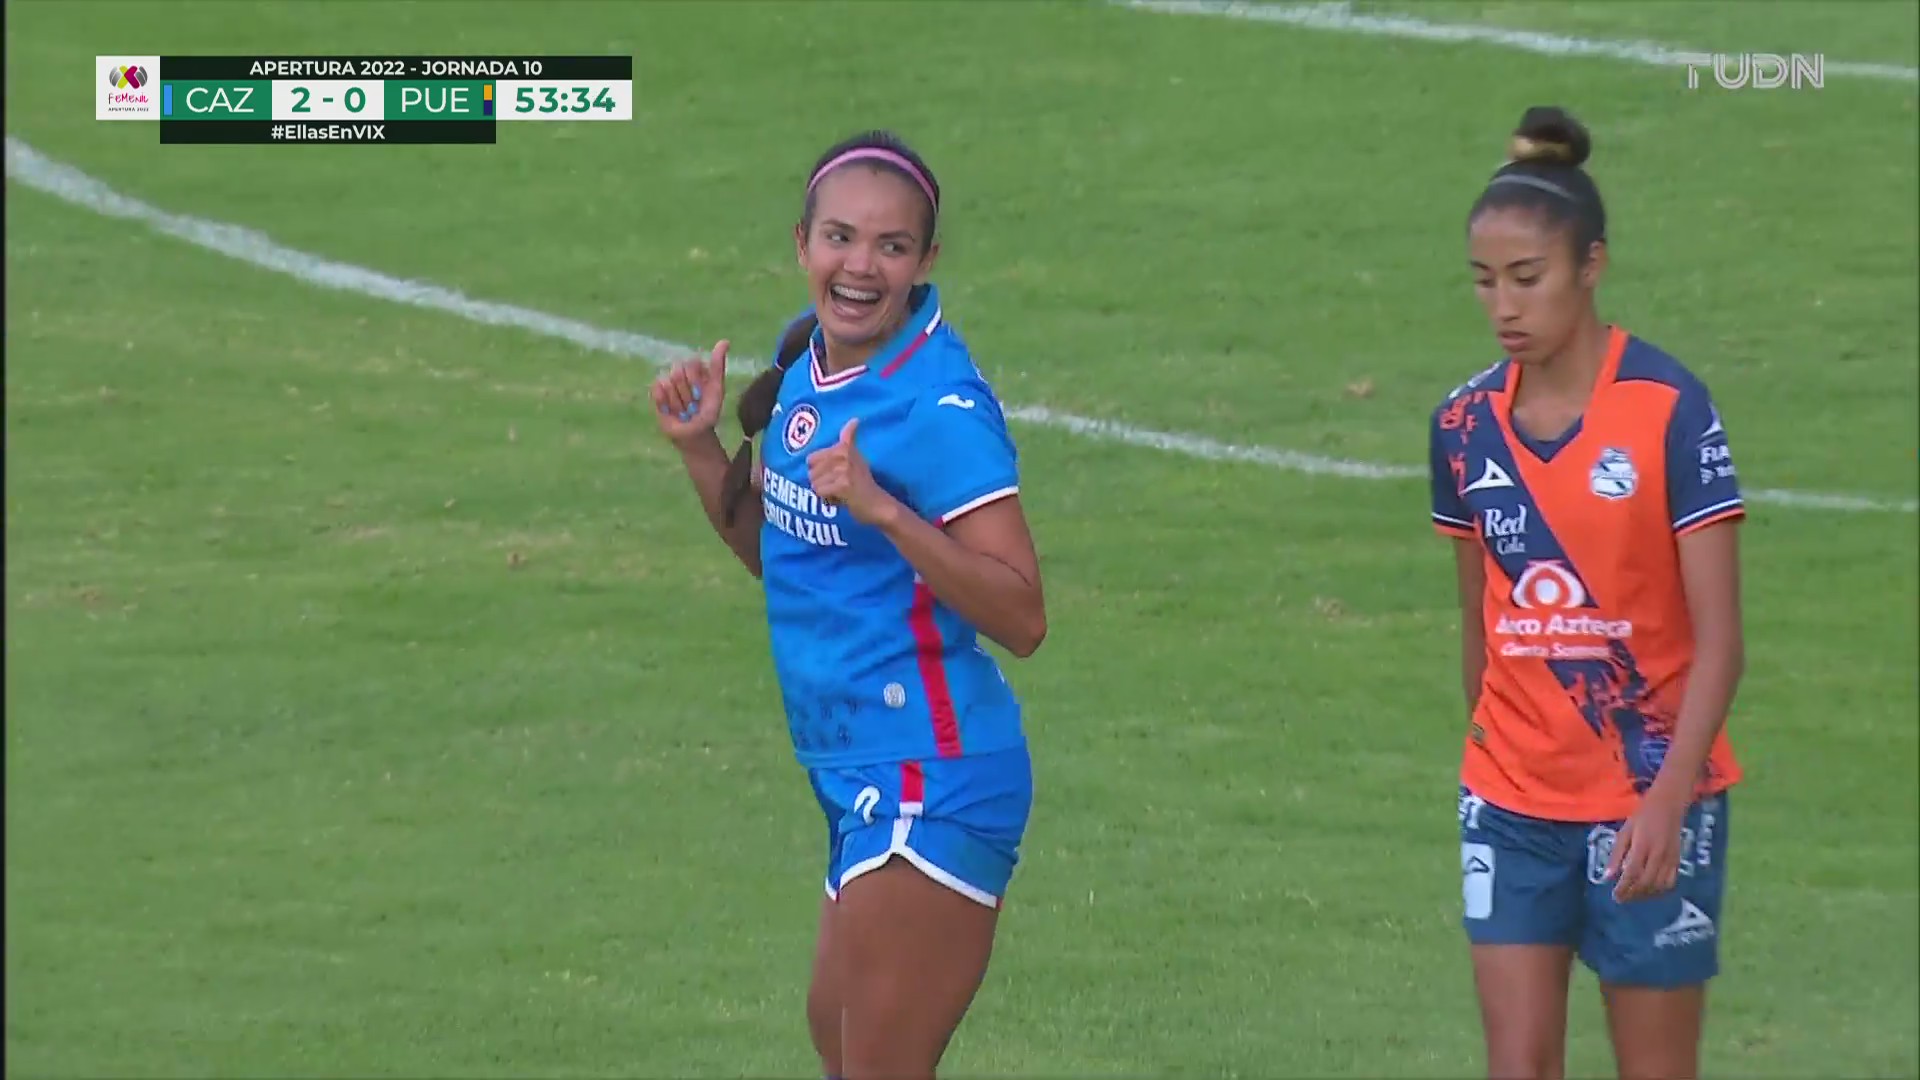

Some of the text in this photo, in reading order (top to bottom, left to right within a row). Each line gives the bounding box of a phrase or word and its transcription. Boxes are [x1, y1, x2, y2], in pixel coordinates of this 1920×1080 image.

[795, 515, 848, 546] AZUL
[1484, 503, 1528, 539] Red
[1545, 613, 1632, 638] Azteca
